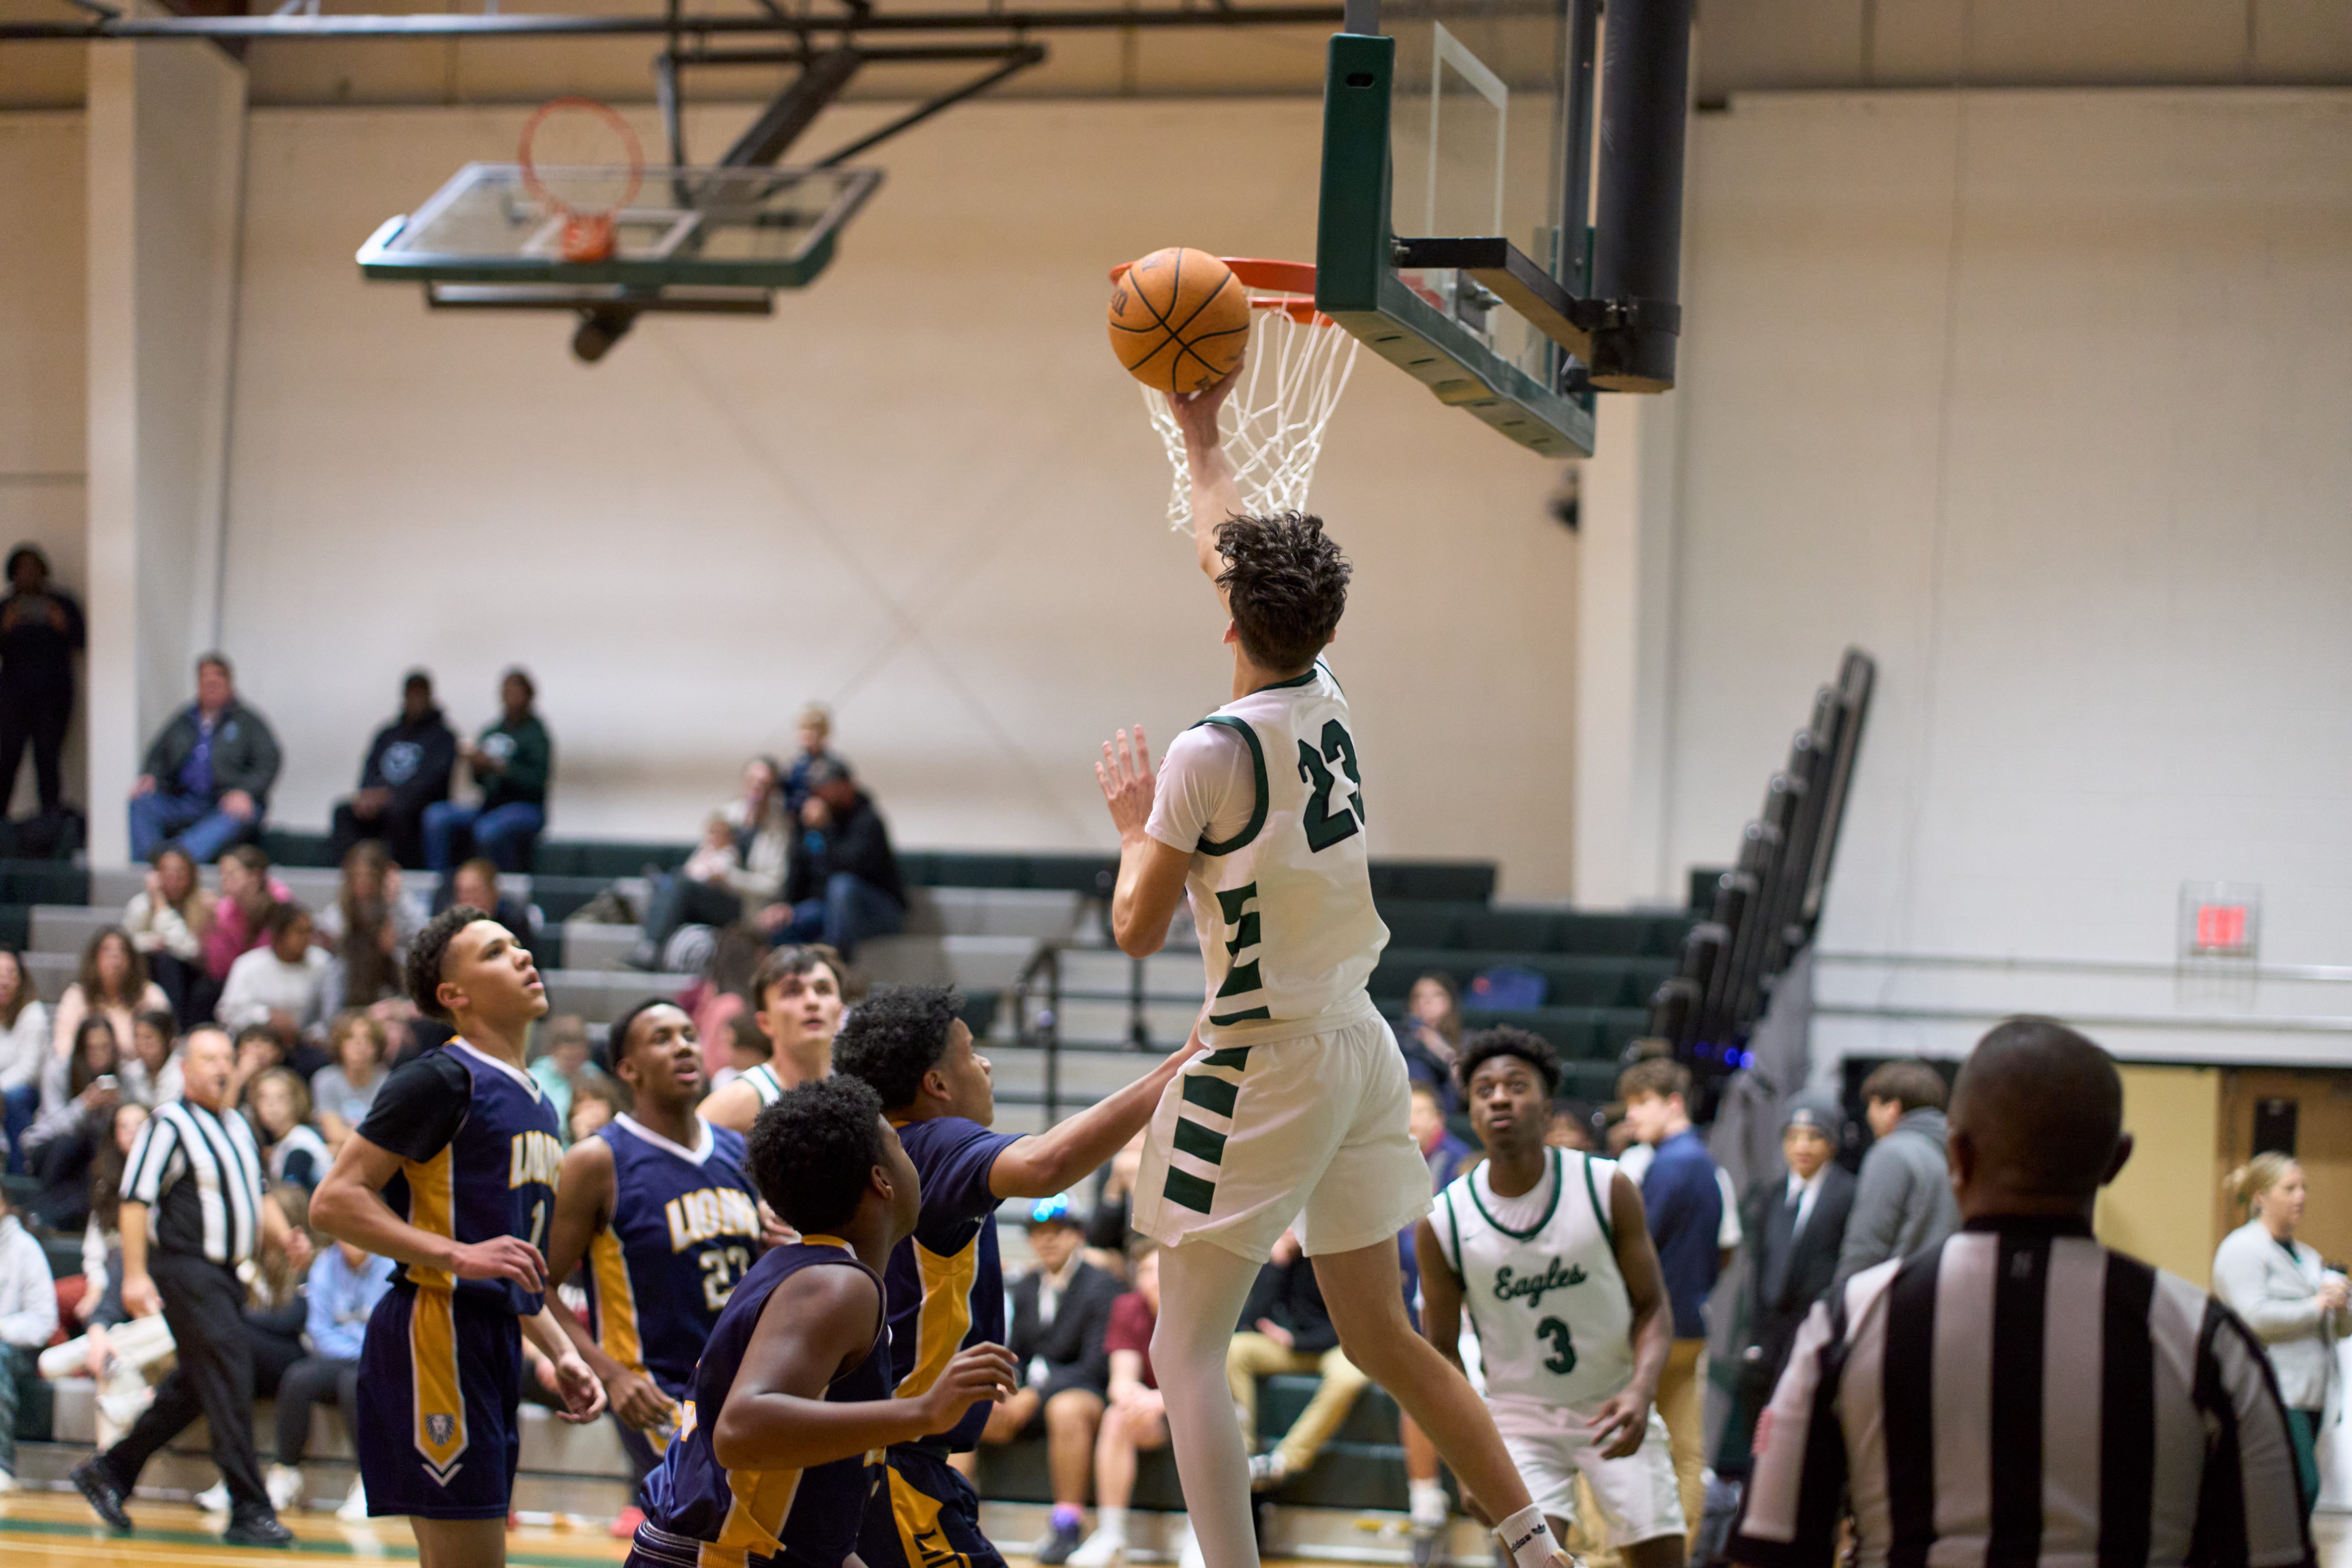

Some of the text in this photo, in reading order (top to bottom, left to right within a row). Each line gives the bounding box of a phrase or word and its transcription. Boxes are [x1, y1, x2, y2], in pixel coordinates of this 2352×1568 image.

[1297, 719, 1365, 853] 23
[509, 1130, 564, 1194] LION
[1493, 1255, 1587, 1308] Eagles
[1537, 1315, 1576, 1375] 3
